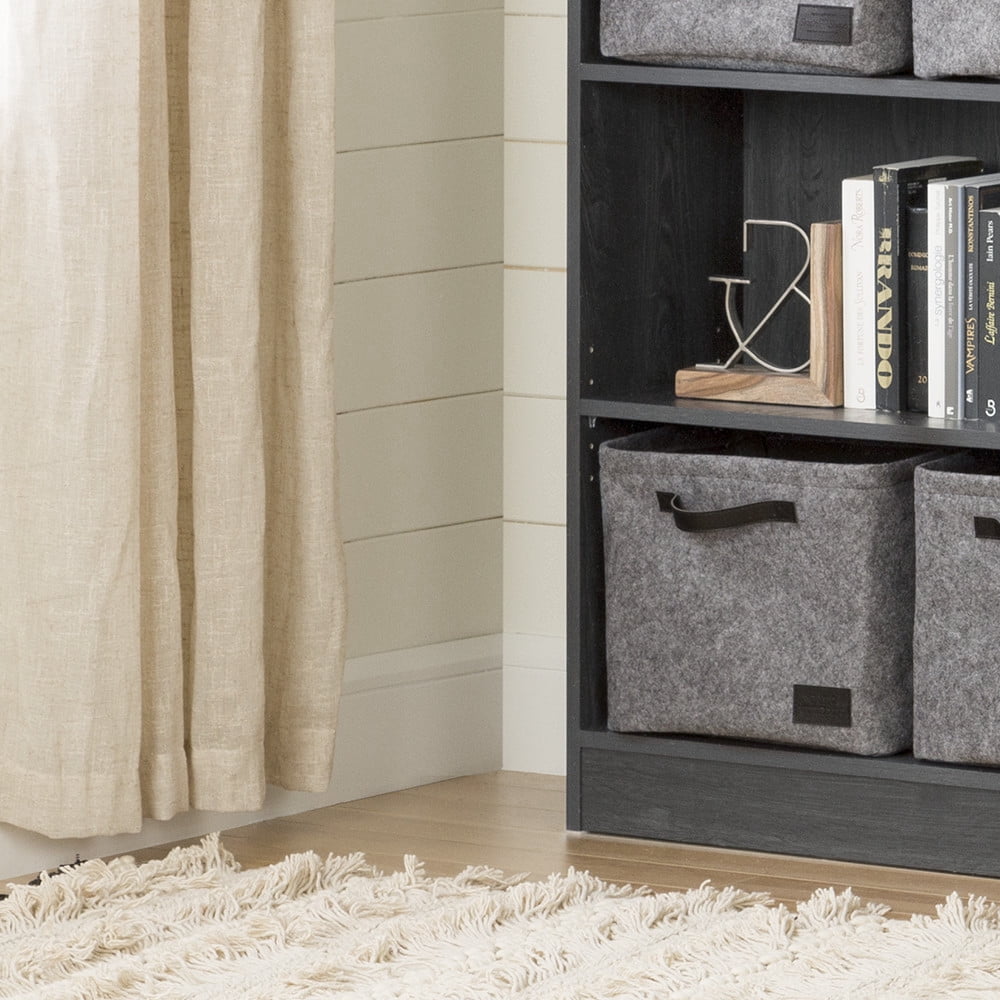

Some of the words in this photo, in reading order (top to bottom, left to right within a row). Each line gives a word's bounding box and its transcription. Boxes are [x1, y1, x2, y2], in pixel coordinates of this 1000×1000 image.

[986, 220, 994, 244] Pears
[986, 245, 994, 262] Iain
[934, 245, 944, 317] synergologie
[986, 281, 995, 310] Bernini
[876, 228, 892, 389] BRANDO
[965, 317, 977, 374] VAMPIRES
